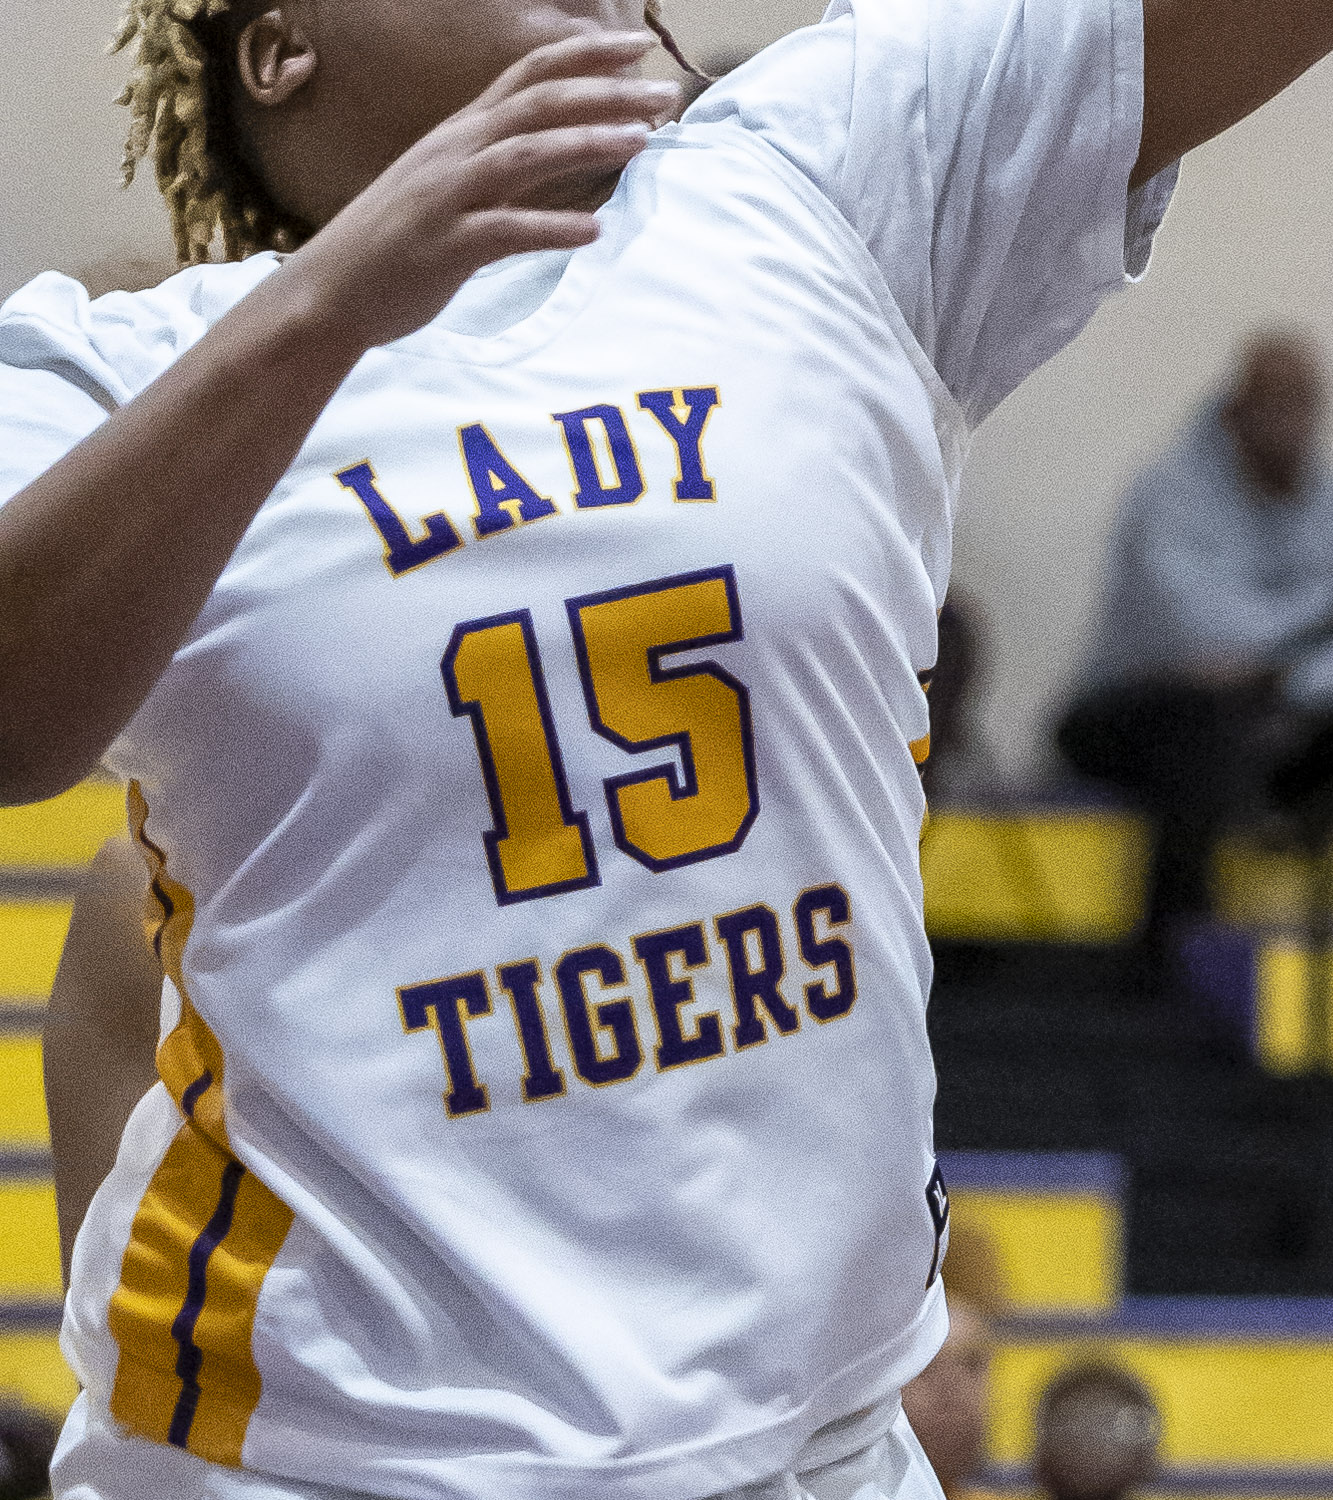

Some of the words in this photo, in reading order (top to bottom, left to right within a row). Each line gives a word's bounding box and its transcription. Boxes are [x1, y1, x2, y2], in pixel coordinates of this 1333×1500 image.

[333, 384, 722, 579] LADY
[439, 563, 761, 907] 15
[397, 882, 858, 1120] TIGERS
